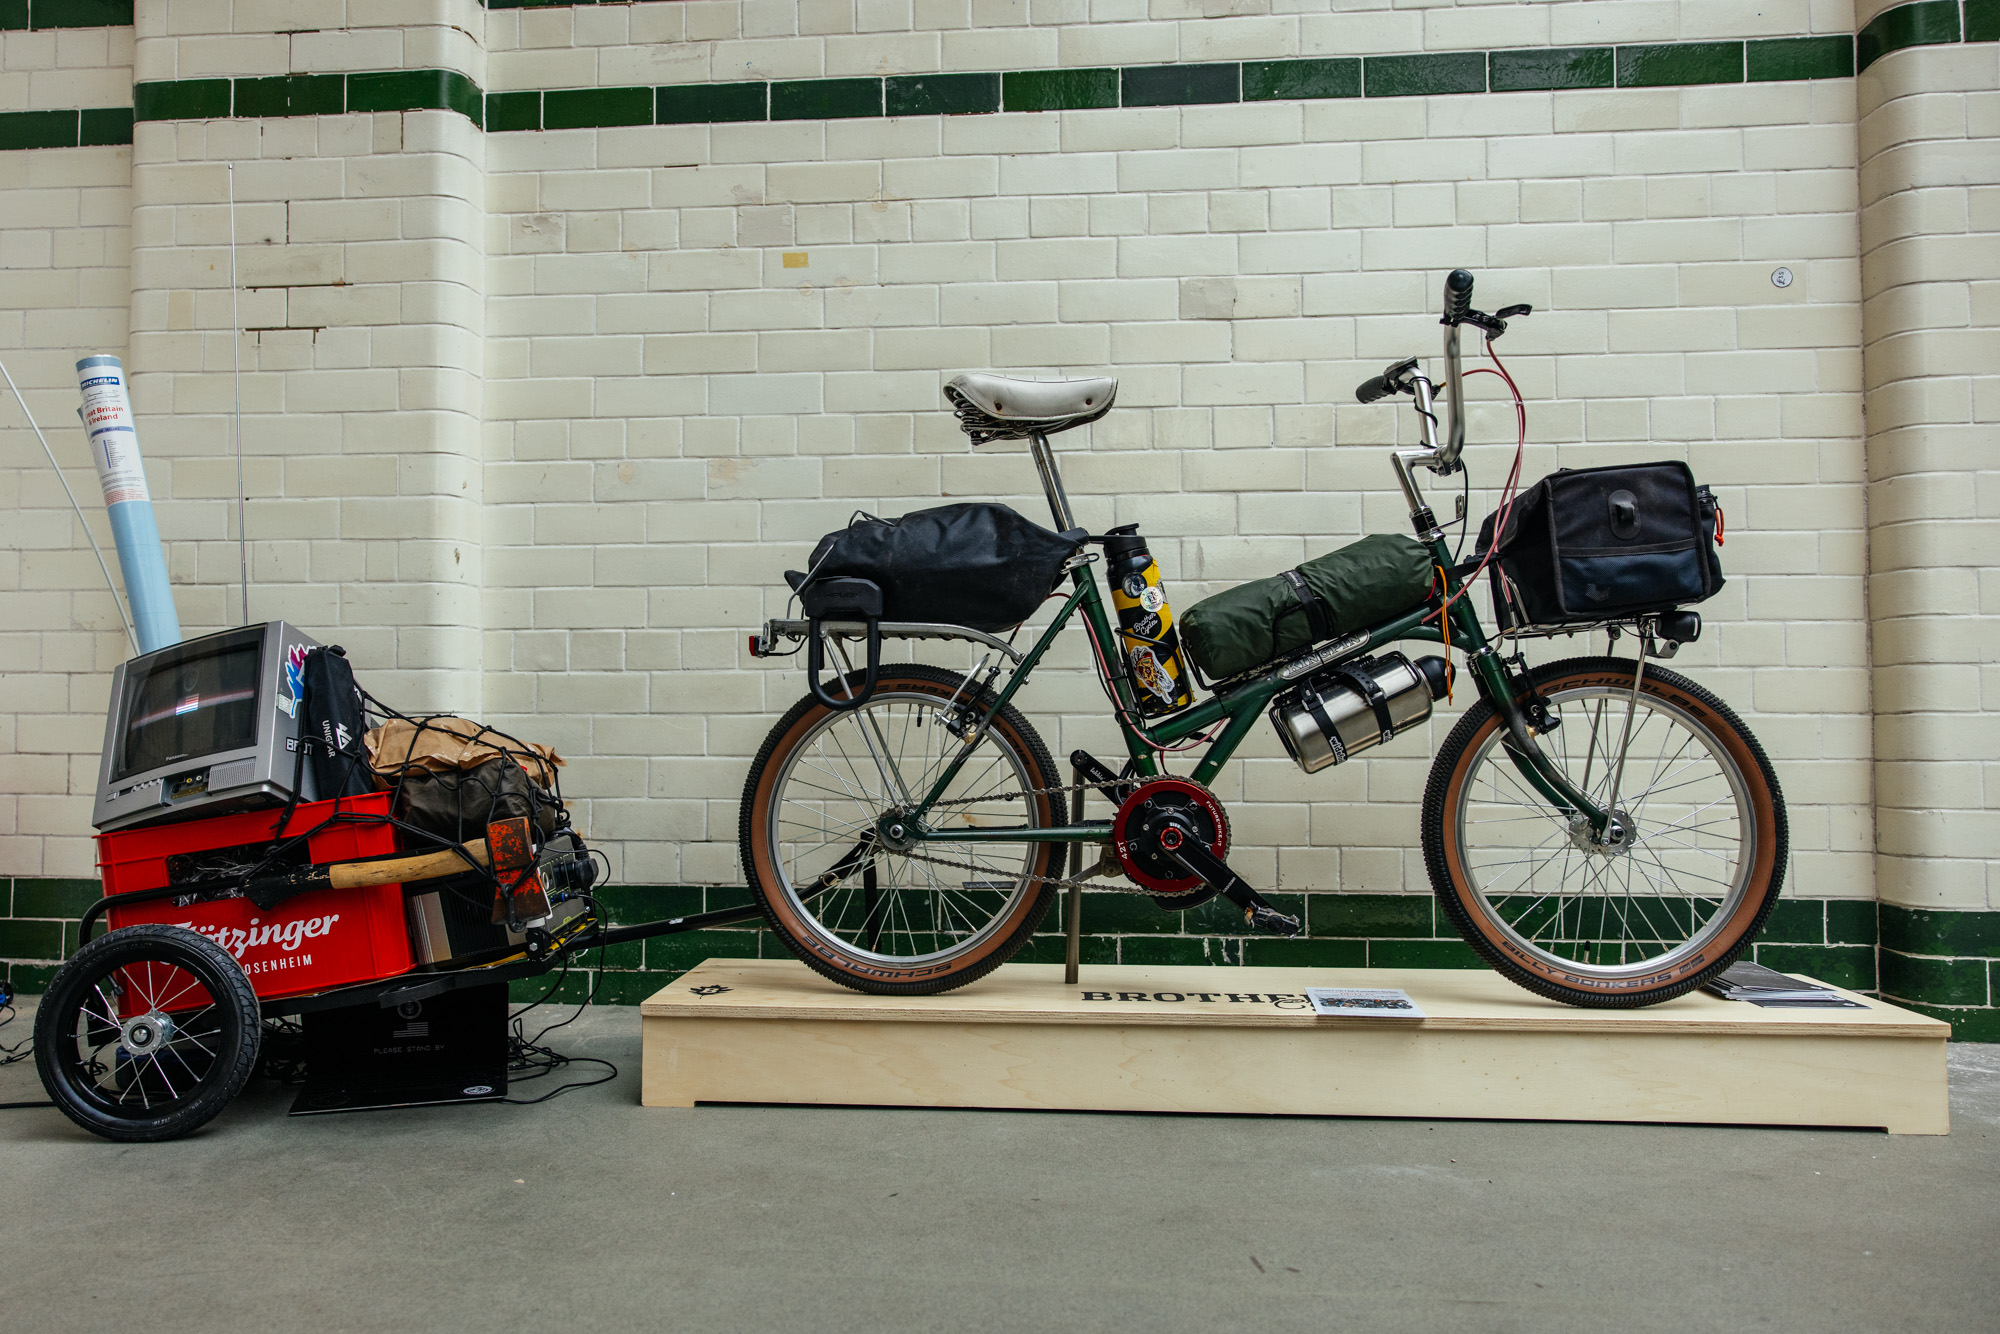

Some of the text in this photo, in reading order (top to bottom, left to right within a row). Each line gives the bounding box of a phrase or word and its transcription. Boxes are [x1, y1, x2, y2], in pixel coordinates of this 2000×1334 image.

[92, 412, 119, 424] Ireland
[97, 404, 124, 414] Britain
[1133, 612, 1157, 634] Brother
[1284, 634, 1362, 674] KINGPIN
[1542, 677, 1708, 719] SCHWALBE
[1205, 800, 1223, 847] FUTURE-BIKE.IT
[1117, 841, 1128, 860] 42T
[172, 914, 340, 959] ötzinger
[244, 954, 313, 976] OSENHEIM
[802, 935, 952, 979] SCHWALBE
[1501, 940, 1673, 990] BILLY BONKERS
[1081, 991, 1314, 1004] BROTHE
[373, 1044, 446, 1055] PLEASE STAND BY
